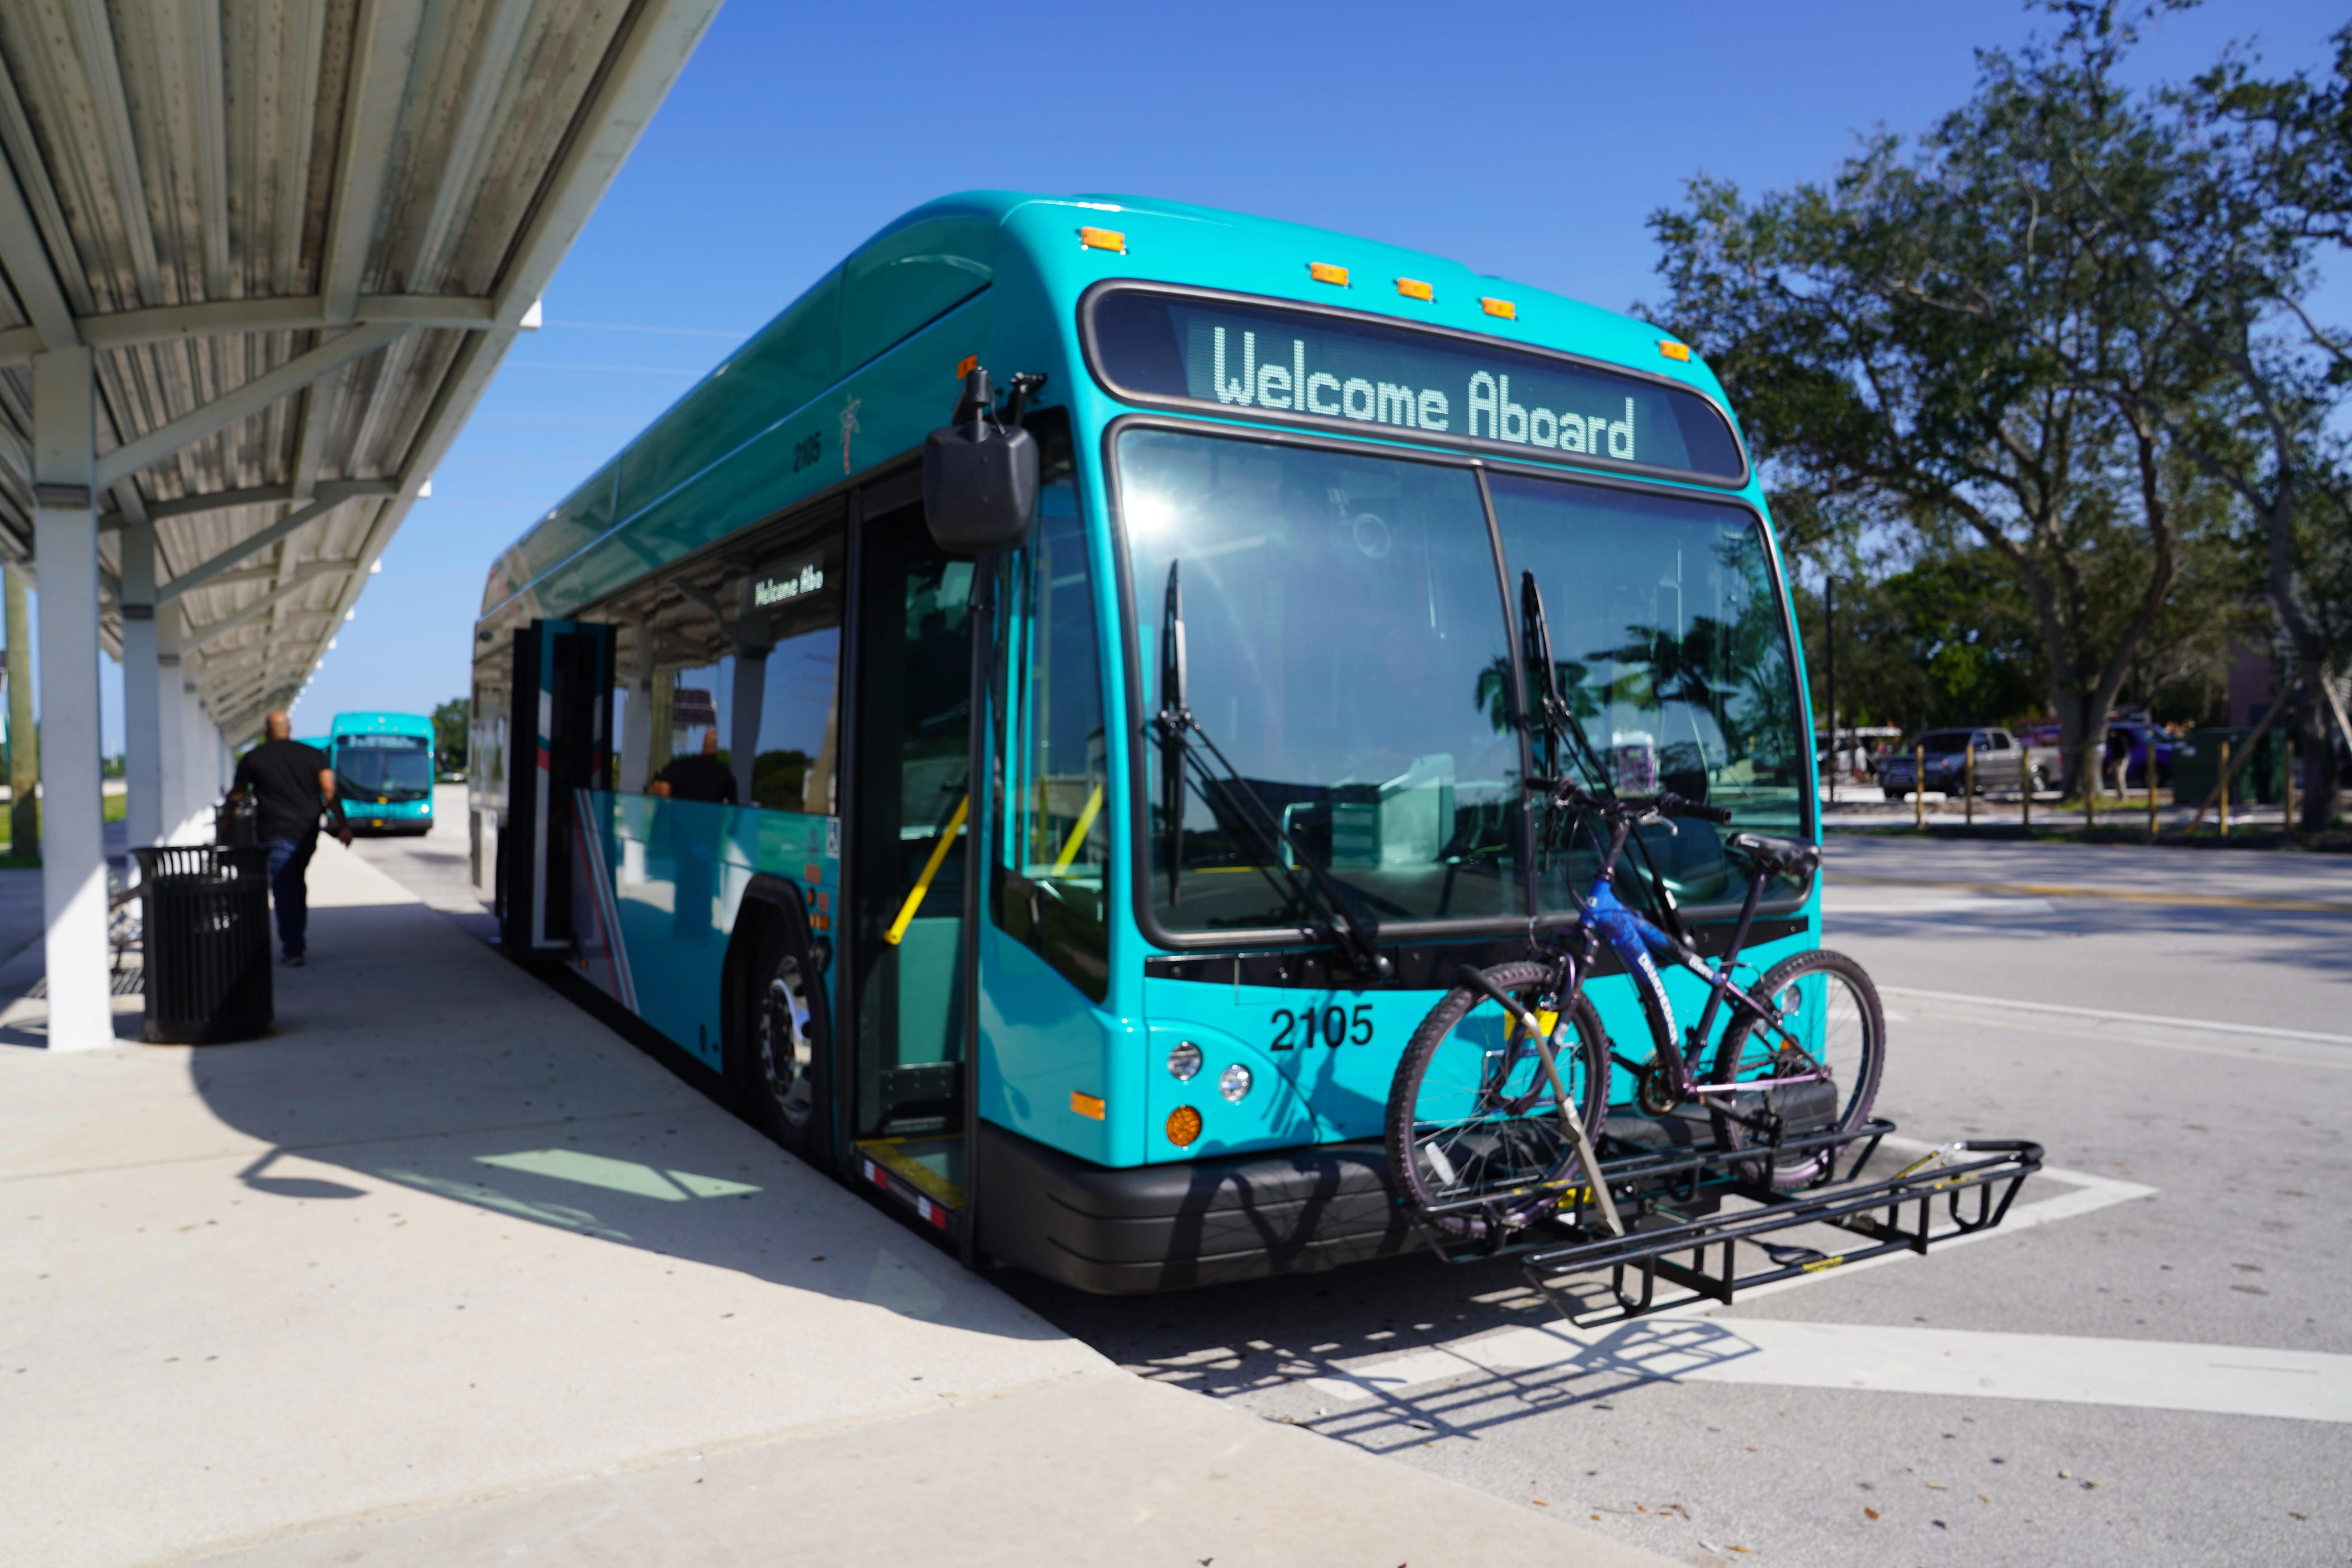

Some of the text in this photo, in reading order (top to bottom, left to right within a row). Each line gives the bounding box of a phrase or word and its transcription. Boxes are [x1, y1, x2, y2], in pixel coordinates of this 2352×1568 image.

[1215, 326, 1635, 460] Welcome Aboard
[1271, 1004, 1373, 1051] 2105
